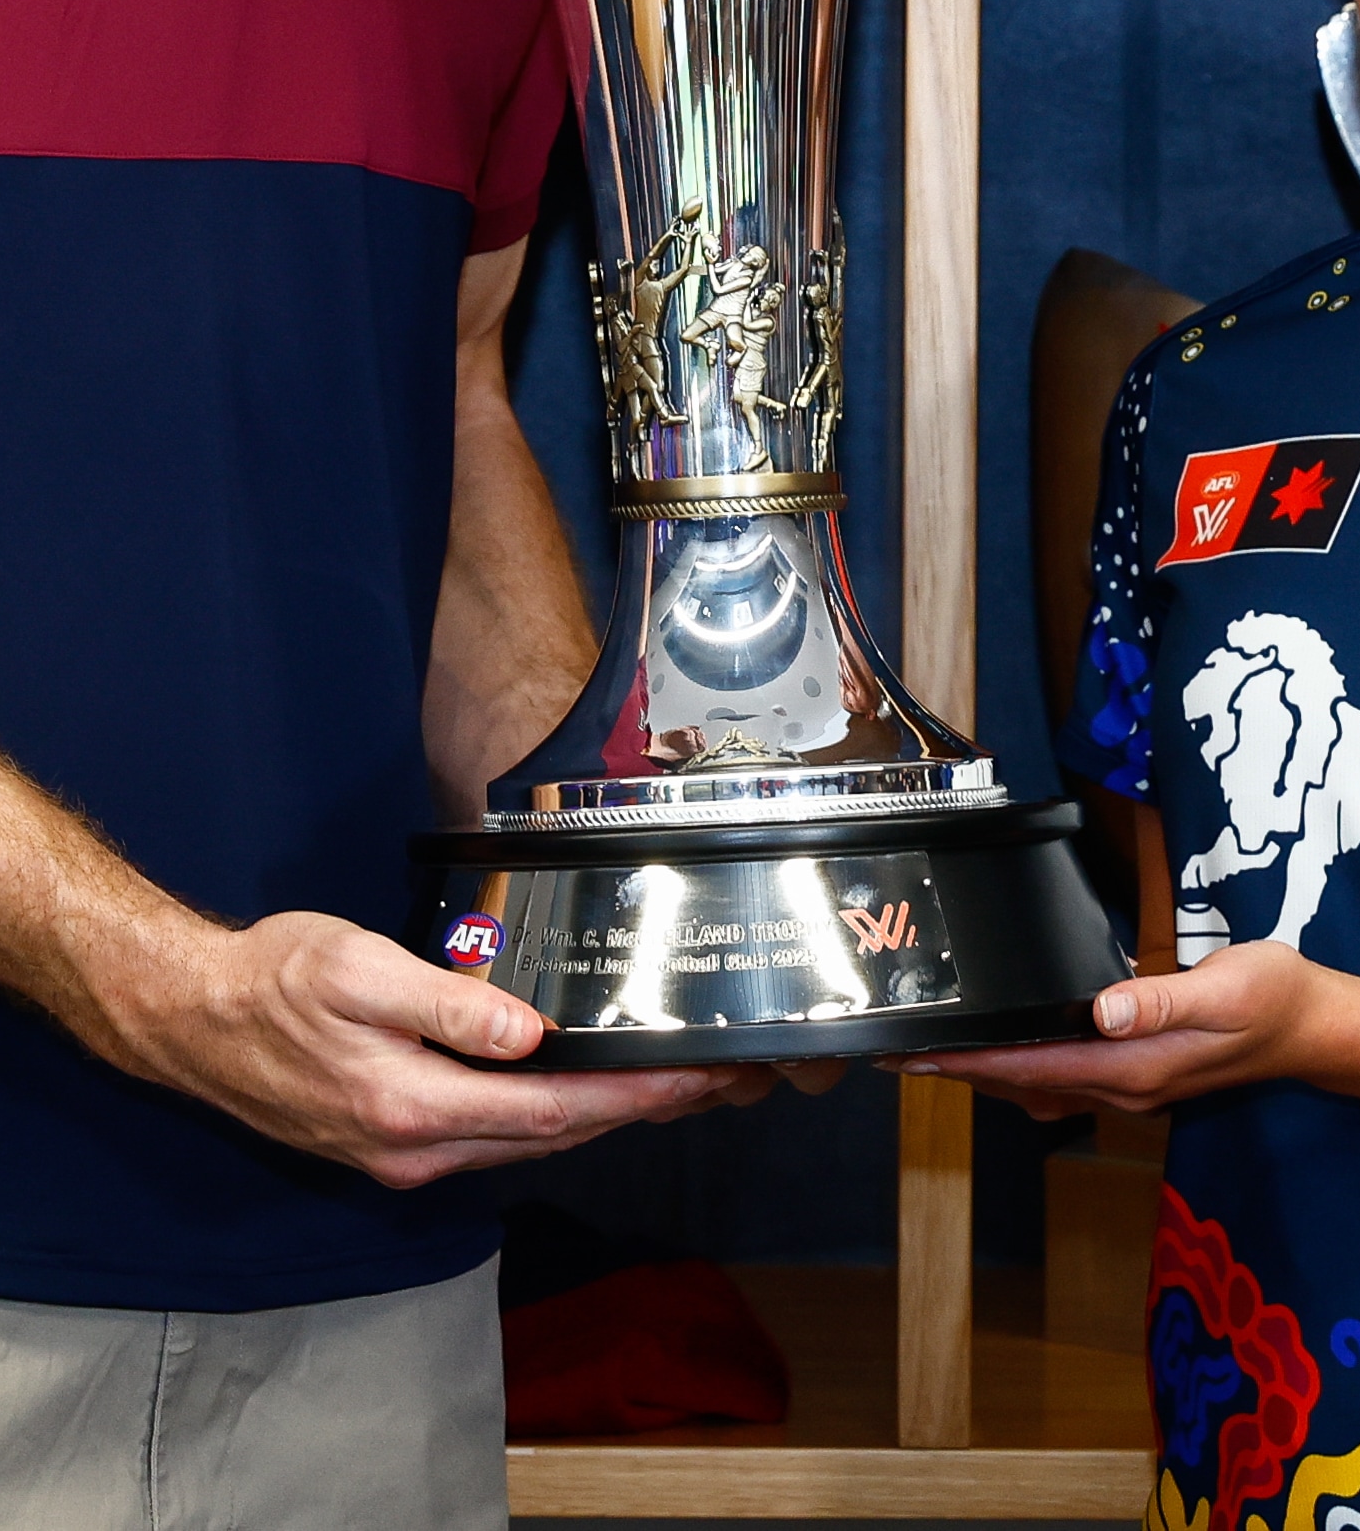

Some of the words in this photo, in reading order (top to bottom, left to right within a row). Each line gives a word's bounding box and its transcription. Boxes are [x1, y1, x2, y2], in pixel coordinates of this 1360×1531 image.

[1204, 476, 1233, 494] AFL
[445, 923, 496, 957] AFL
[512, 926, 532, 945] Dr.
[540, 927, 577, 948] Wm.
[521, 955, 590, 975] Brisbane
[724, 952, 768, 971] Club
